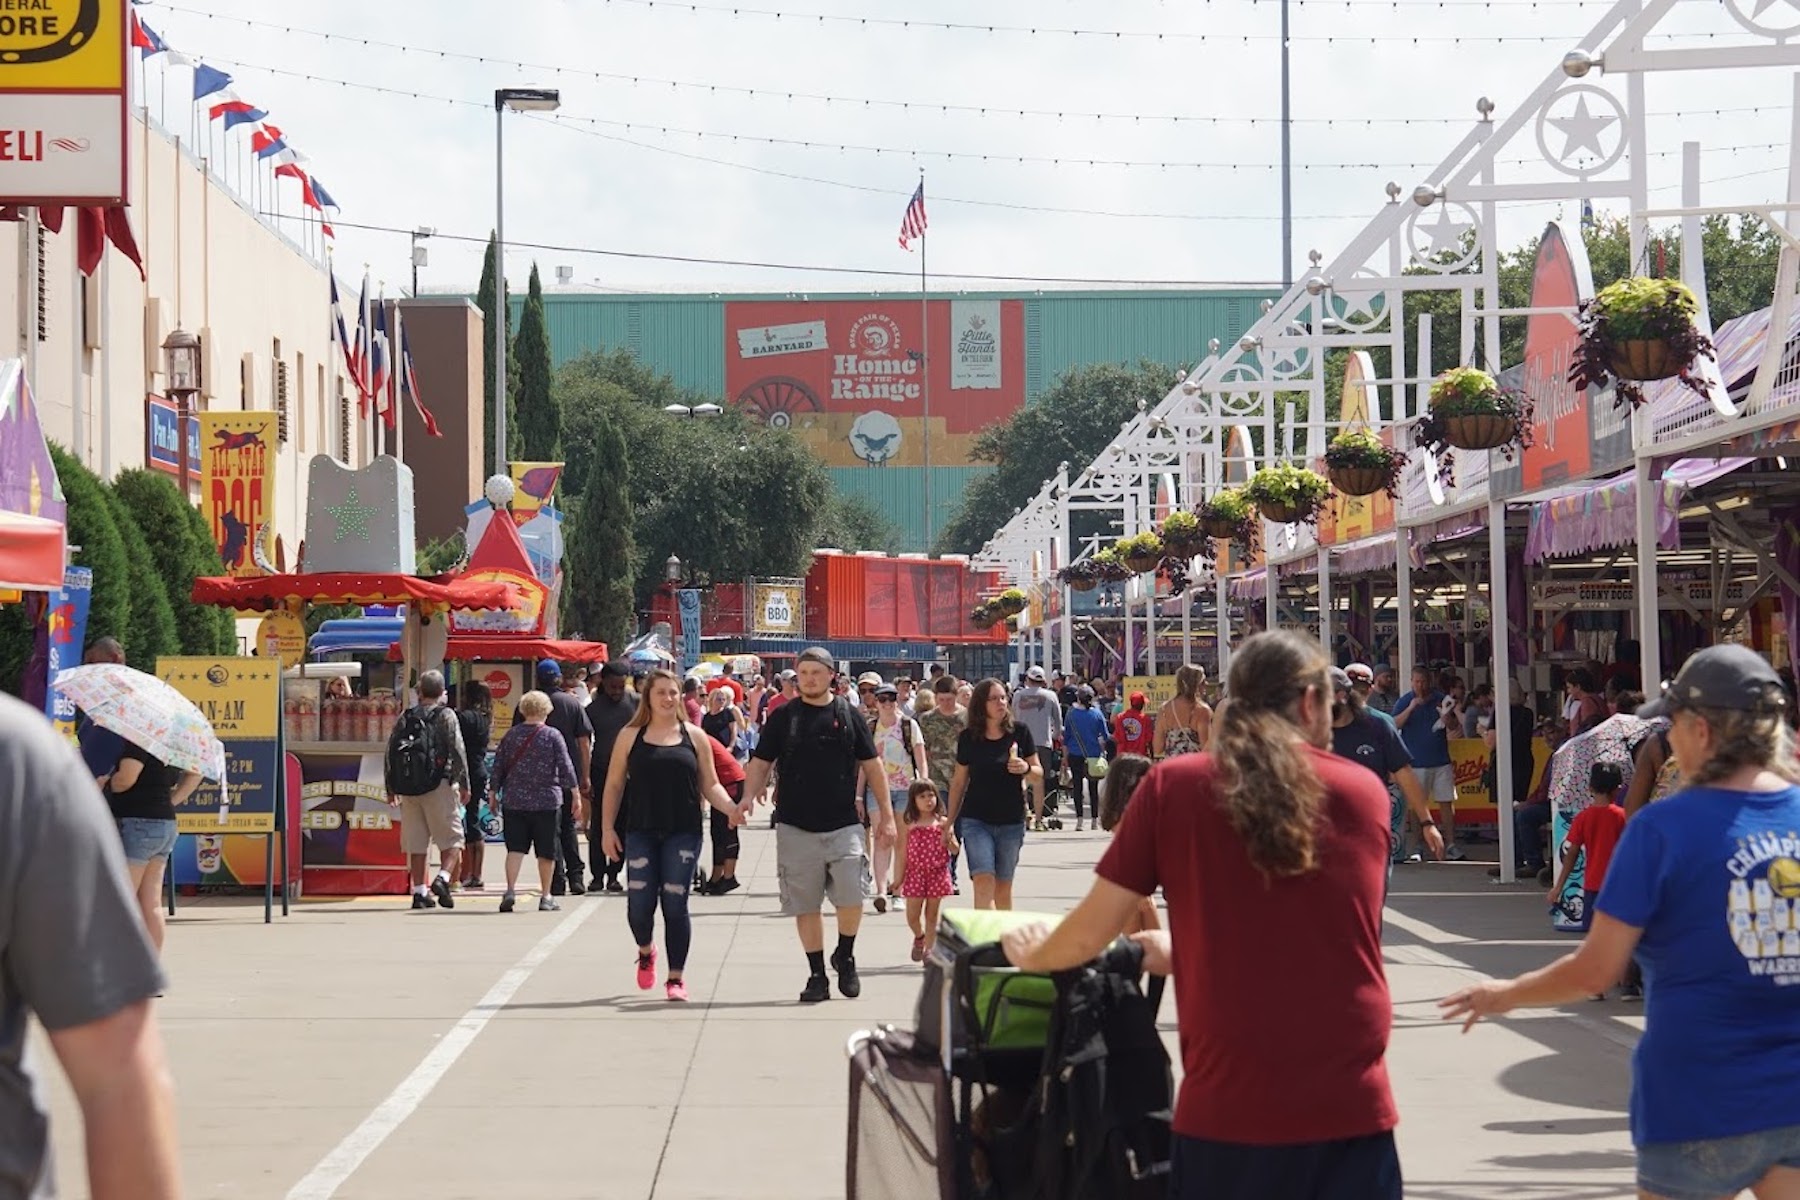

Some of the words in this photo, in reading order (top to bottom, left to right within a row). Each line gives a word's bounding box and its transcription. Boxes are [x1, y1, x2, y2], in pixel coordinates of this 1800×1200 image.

[0, 0, 52, 10] ERAL
[0, 16, 58, 36] ORE
[858, 313, 878, 324] FAIR
[960, 329, 995, 344] Little
[752, 341, 813, 355] BARNYARD
[957, 342, 997, 354] Hands
[833, 354, 917, 375] Home
[831, 378, 921, 402] Range
[211, 478, 263, 568] DOG
[1579, 589, 1609, 600] CORNY
[1611, 589, 1633, 600] DOGS
[1689, 589, 1712, 599] CORN
[1725, 589, 1743, 599] OGS
[767, 607, 789, 621] BBQ
[190, 700, 245, 720] AN-AM
[240, 760, 254, 774] PM
[345, 812, 393, 830] TEA
